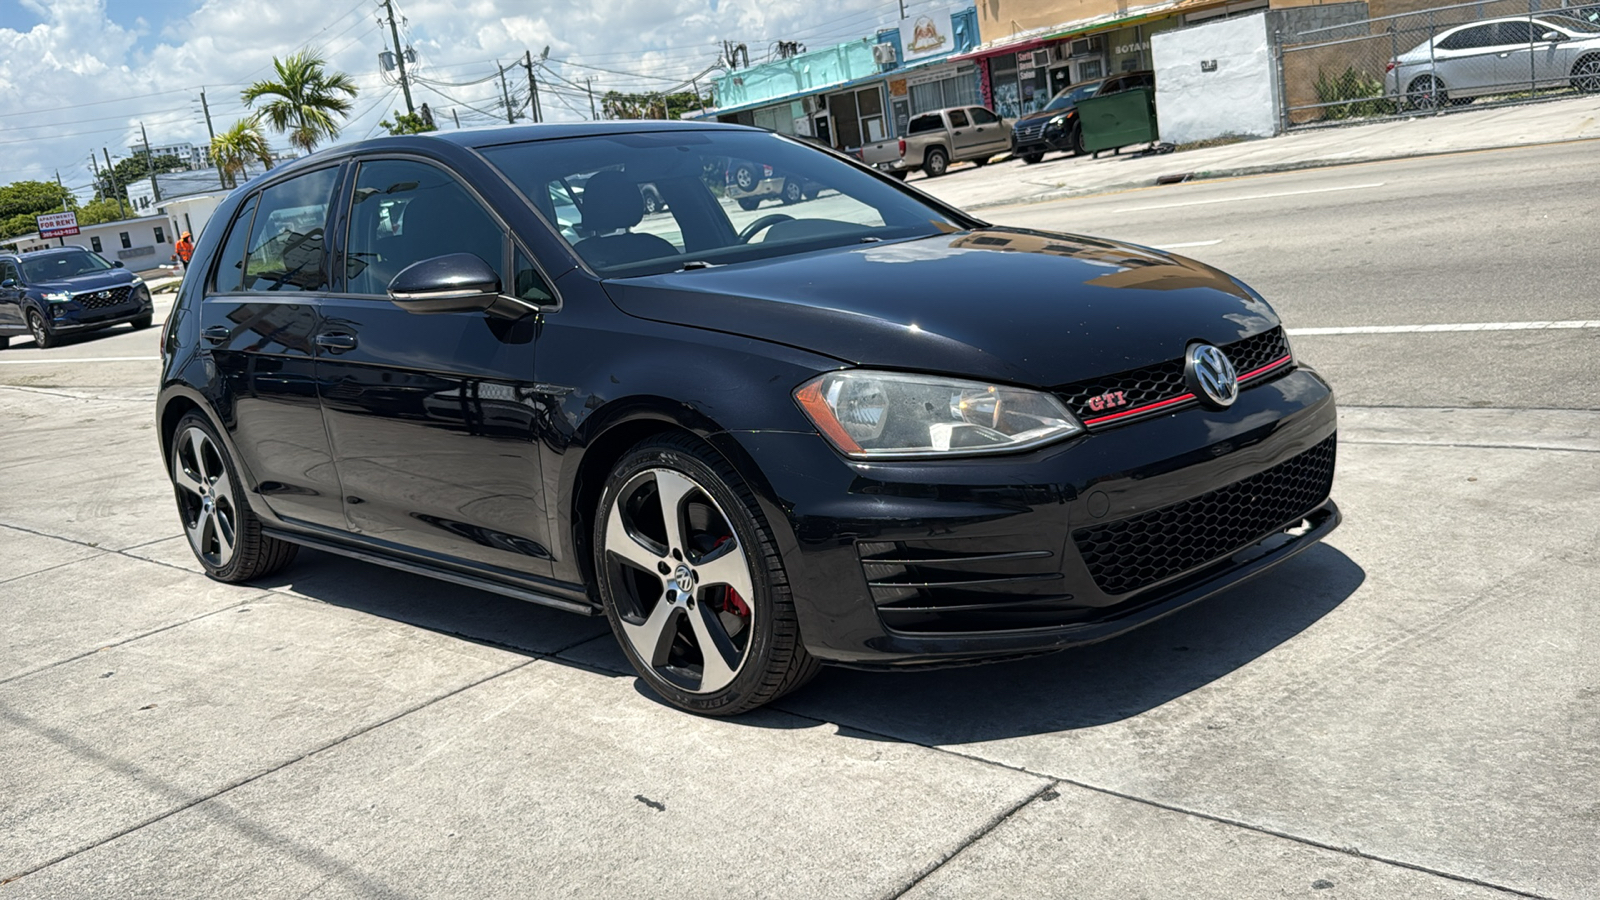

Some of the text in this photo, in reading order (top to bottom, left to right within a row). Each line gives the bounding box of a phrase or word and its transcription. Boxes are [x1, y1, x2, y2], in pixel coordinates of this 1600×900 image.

[39, 213, 74, 221] APARTMENTS
[40, 218, 75, 228] FOR RENT
[1089, 391, 1126, 411] GTI
